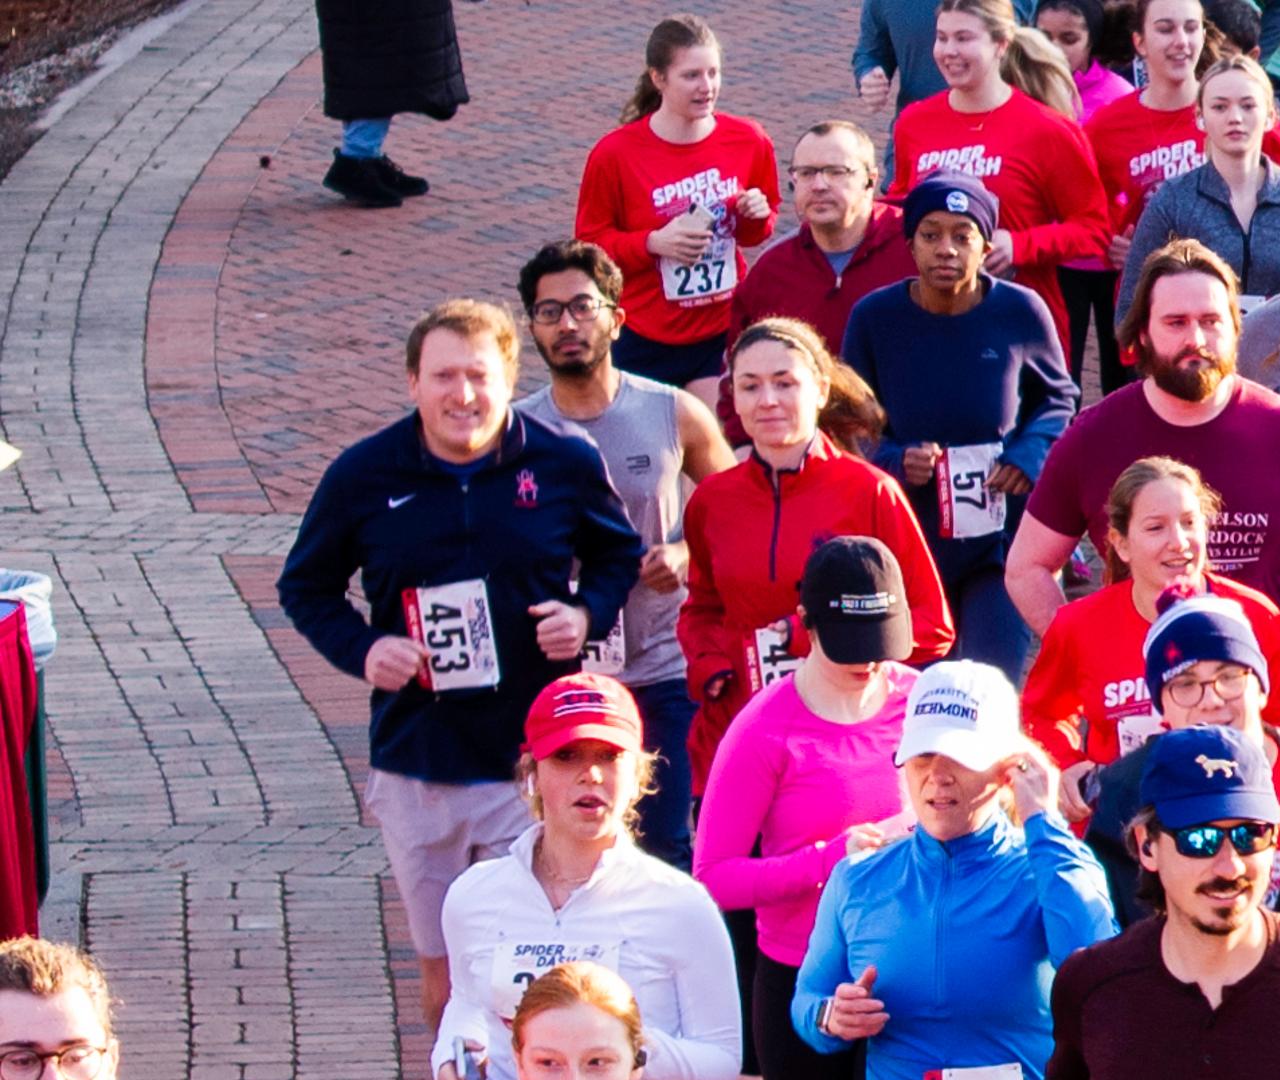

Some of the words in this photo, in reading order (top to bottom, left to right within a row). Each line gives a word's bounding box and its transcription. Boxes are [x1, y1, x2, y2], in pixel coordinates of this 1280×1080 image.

[917, 144, 986, 174] SPIDER
[1130, 139, 1198, 177] SPIDER
[652, 167, 722, 208] SPIDER
[690, 176, 739, 206] DASH
[673, 260, 727, 297] 237
[952, 470, 987, 511] 57
[1211, 511, 1270, 528] ELSON
[1206, 530, 1268, 546] RDOCK
[424, 602, 471, 676] 453
[1104, 676, 1151, 708] SPI
[913, 702, 979, 722] RICHMOND
[514, 943, 565, 957] SPIDER
